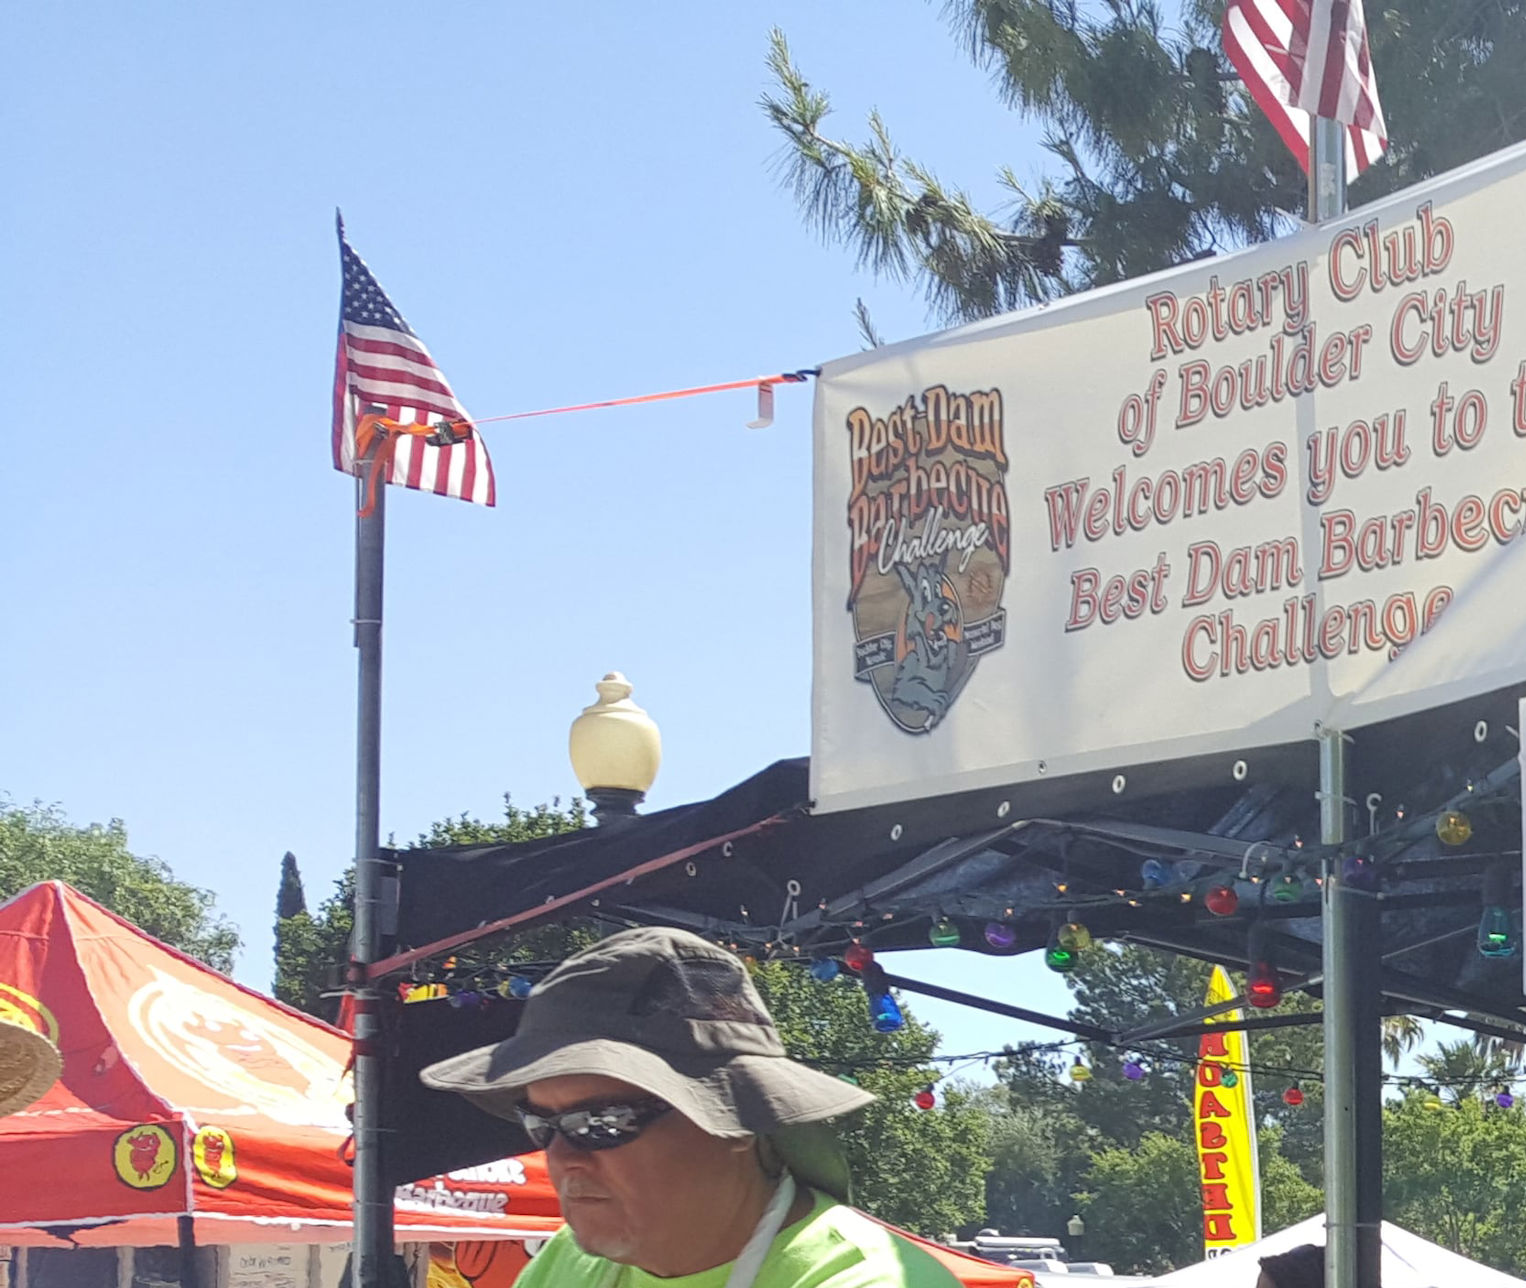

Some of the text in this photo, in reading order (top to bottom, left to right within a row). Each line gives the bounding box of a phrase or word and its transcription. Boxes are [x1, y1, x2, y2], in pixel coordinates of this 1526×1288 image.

[1146, 200, 1454, 361] Rotary Club
[1118, 280, 1504, 458] of Boulder City
[847, 384, 1008, 501] Best Dam
[1045, 440, 1288, 552] Welcomes
[1307, 409, 1411, 506] you
[1431, 381, 1488, 456] to
[848, 457, 1010, 608] Barbecue
[878, 504, 989, 574] Challenge
[1064, 552, 1171, 634] Best
[1182, 535, 1304, 608] Dam
[1182, 586, 1454, 682] Challenge
